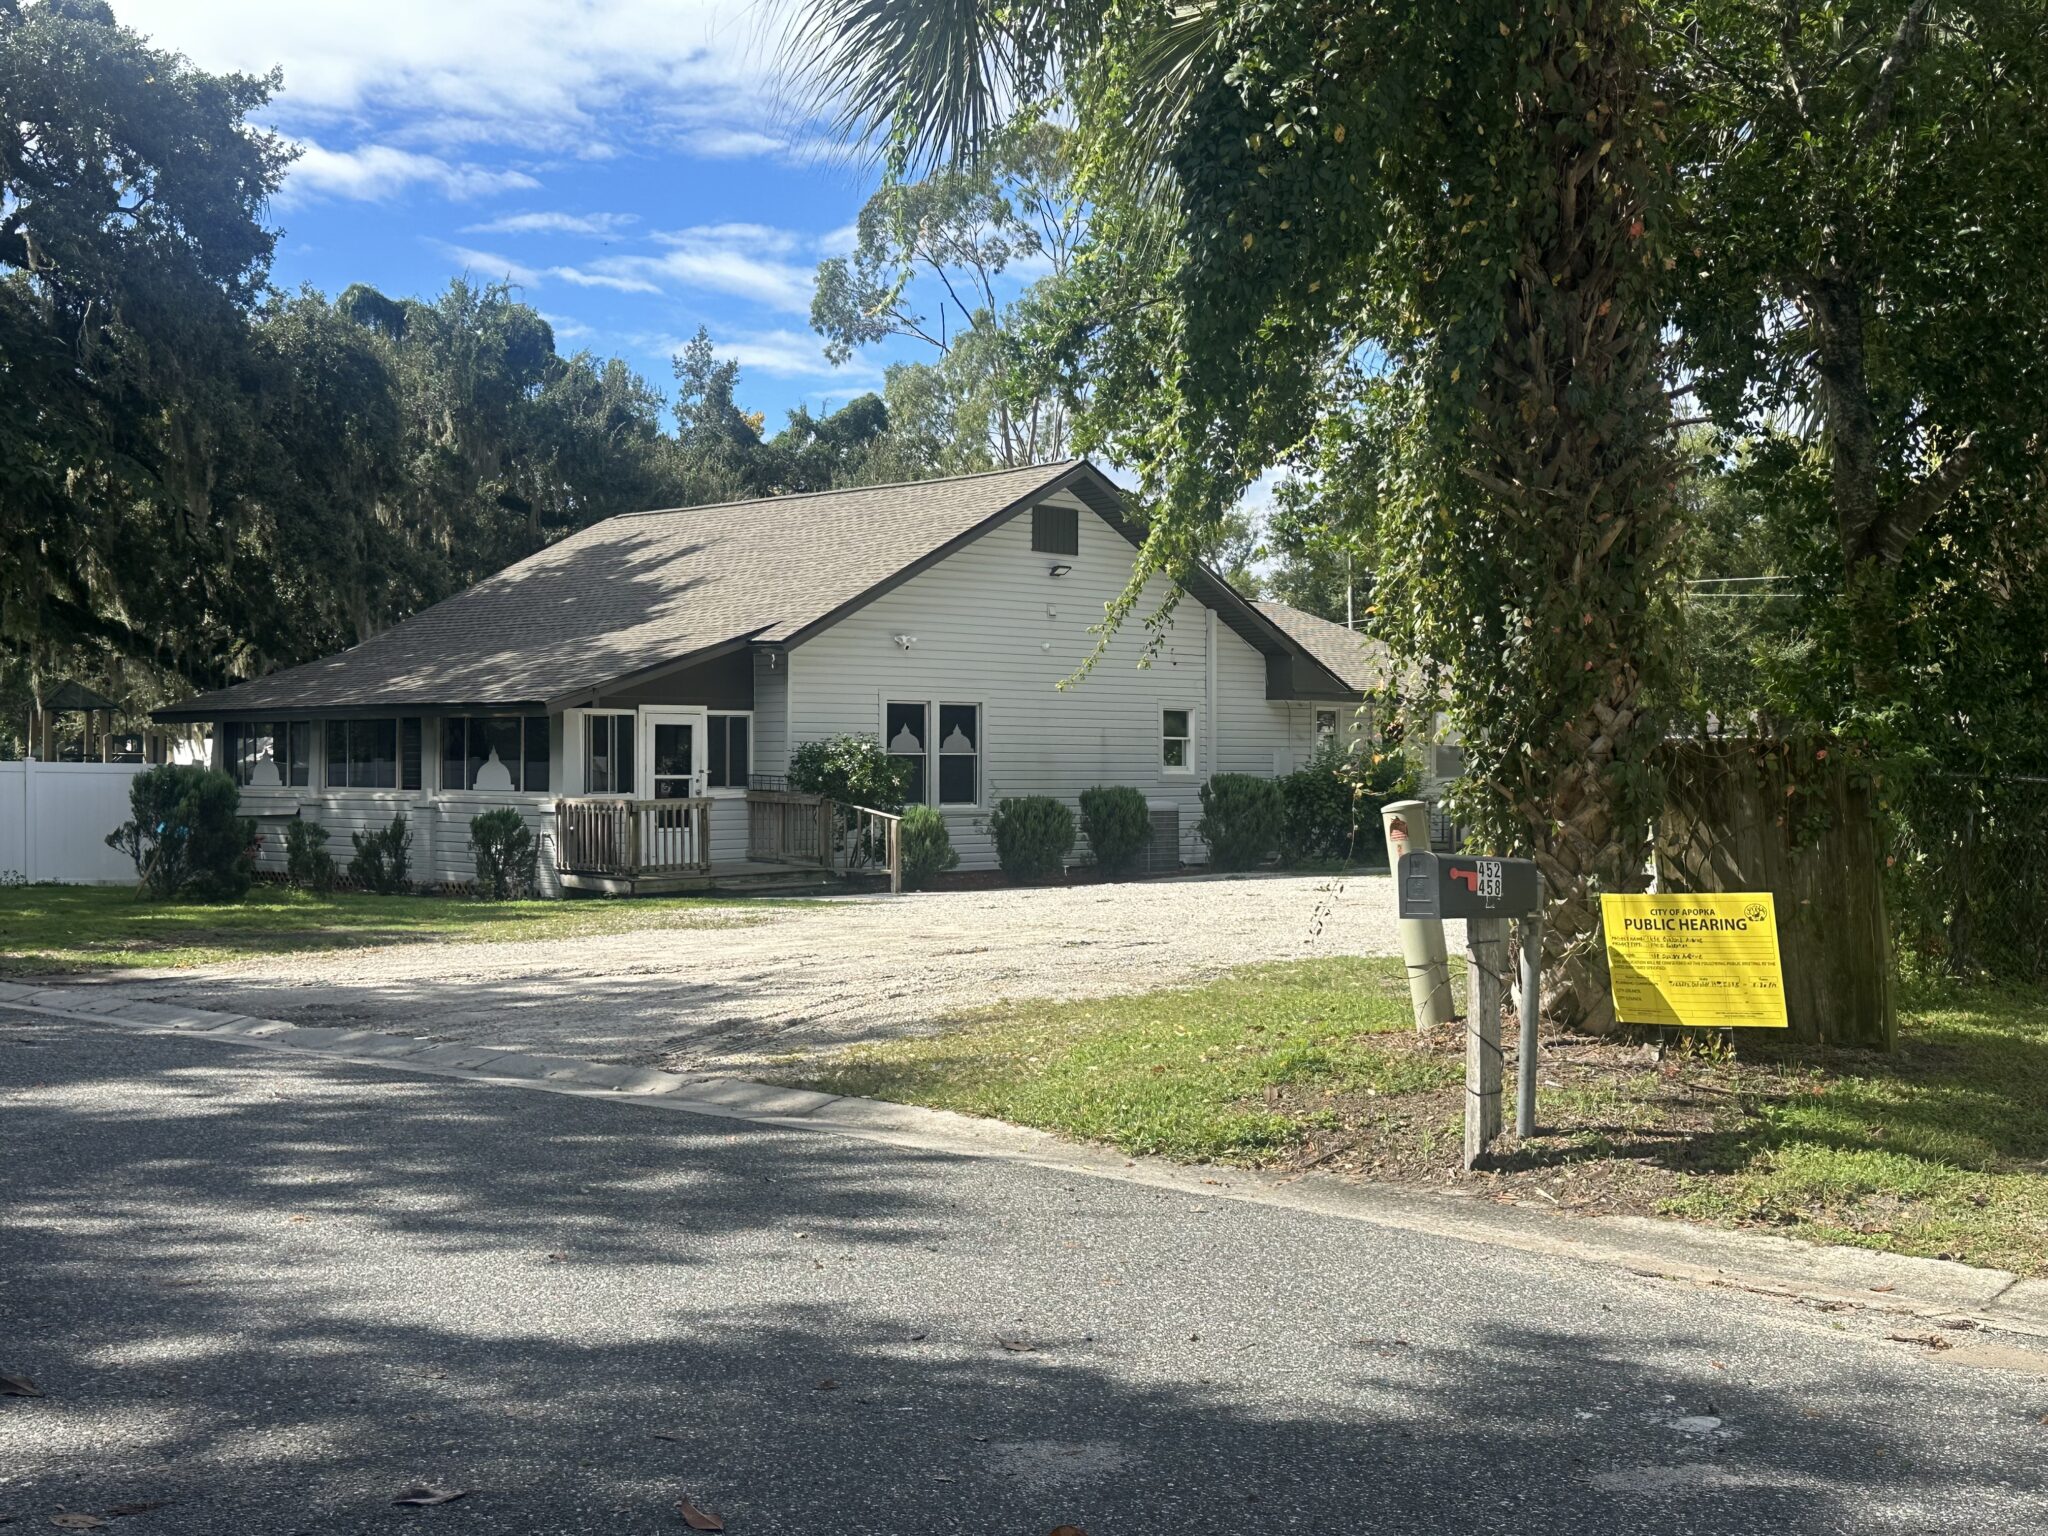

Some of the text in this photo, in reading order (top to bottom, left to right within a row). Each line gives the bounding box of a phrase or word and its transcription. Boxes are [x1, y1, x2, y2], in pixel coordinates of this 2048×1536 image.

[1479, 863, 1500, 878] 452
[1479, 879, 1501, 895] 458
[1650, 908, 1716, 916] CITY OF APOPKA
[1624, 918, 1748, 931] PUBLIC HEARING
